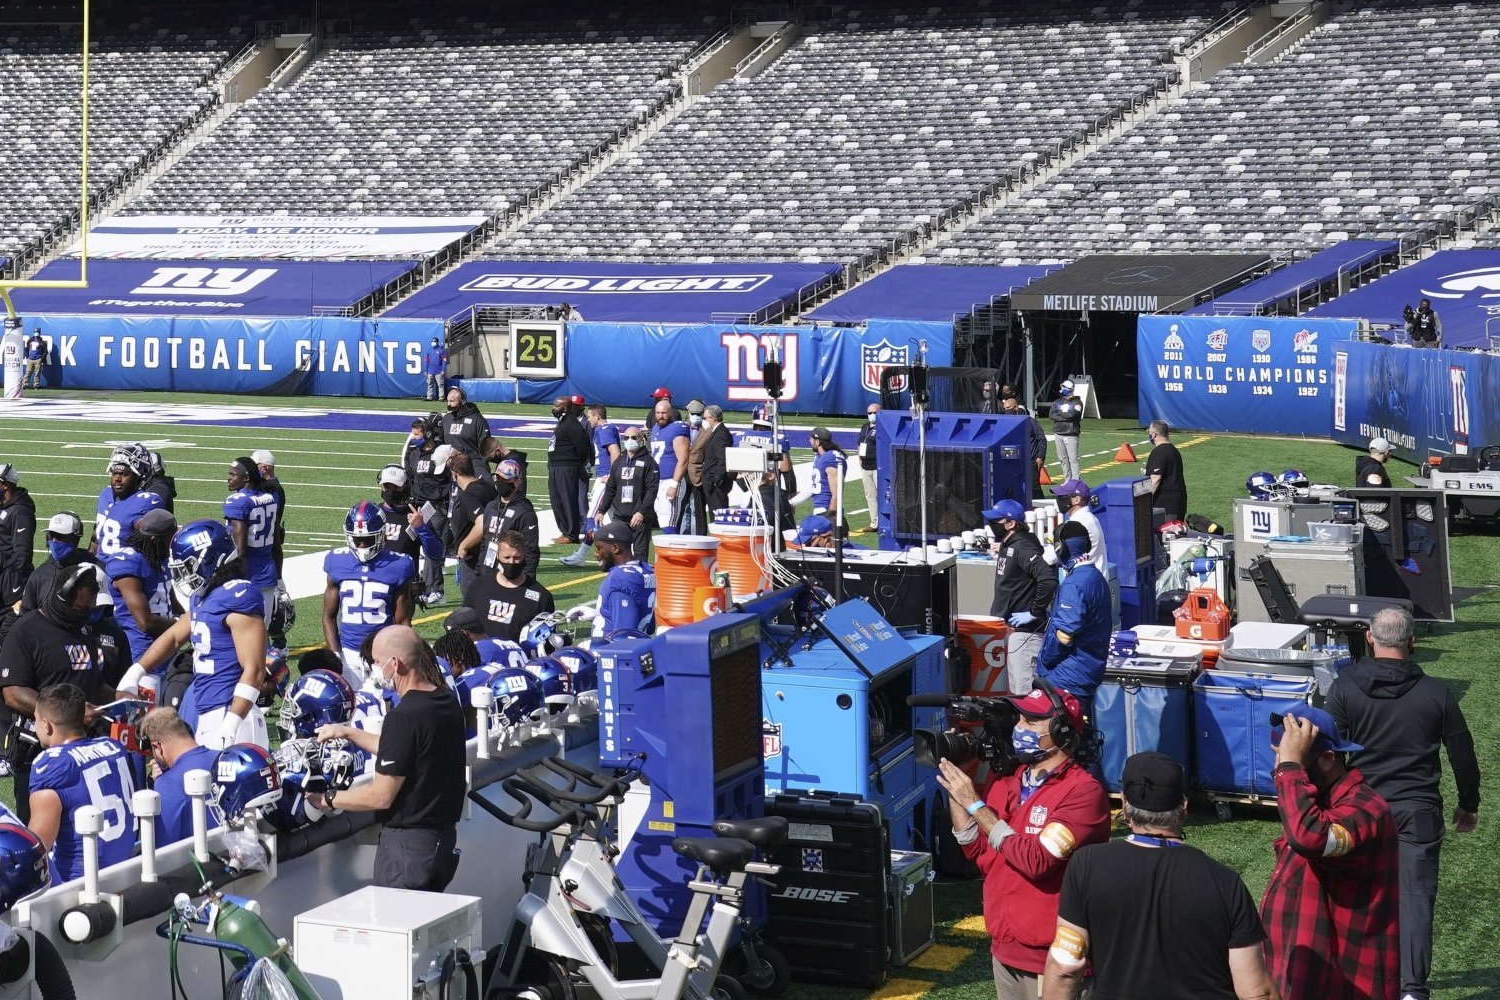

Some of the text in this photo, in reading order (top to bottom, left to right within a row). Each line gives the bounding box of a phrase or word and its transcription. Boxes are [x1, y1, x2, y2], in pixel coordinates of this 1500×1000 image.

[176, 227, 249, 235] TODAY,
[484, 275, 597, 291] BUD
[89, 299, 244, 308] #TogetherBlue
[1044, 294, 1158, 311] METLIFE STADIUM
[99, 336, 273, 371] FOOTBALL
[295, 339, 422, 374] GIANTS
[519, 335, 554, 362] 25
[1164, 352, 1316, 364] 2011 2007 1990 1986
[1157, 364, 1327, 384] WORLD CHAMPIONS
[1165, 383, 1318, 396] 1956 1938 1934 1927
[1470, 482, 1493, 490] EMS
[249, 504, 277, 548] 27
[1251, 510, 1271, 533] ny
[338, 581, 394, 625] 25
[603, 671, 616, 752] GIANTS
[69, 741, 121, 767] MARTINEZ
[82, 757, 139, 842] 54
[772, 887, 859, 903] BOSE
